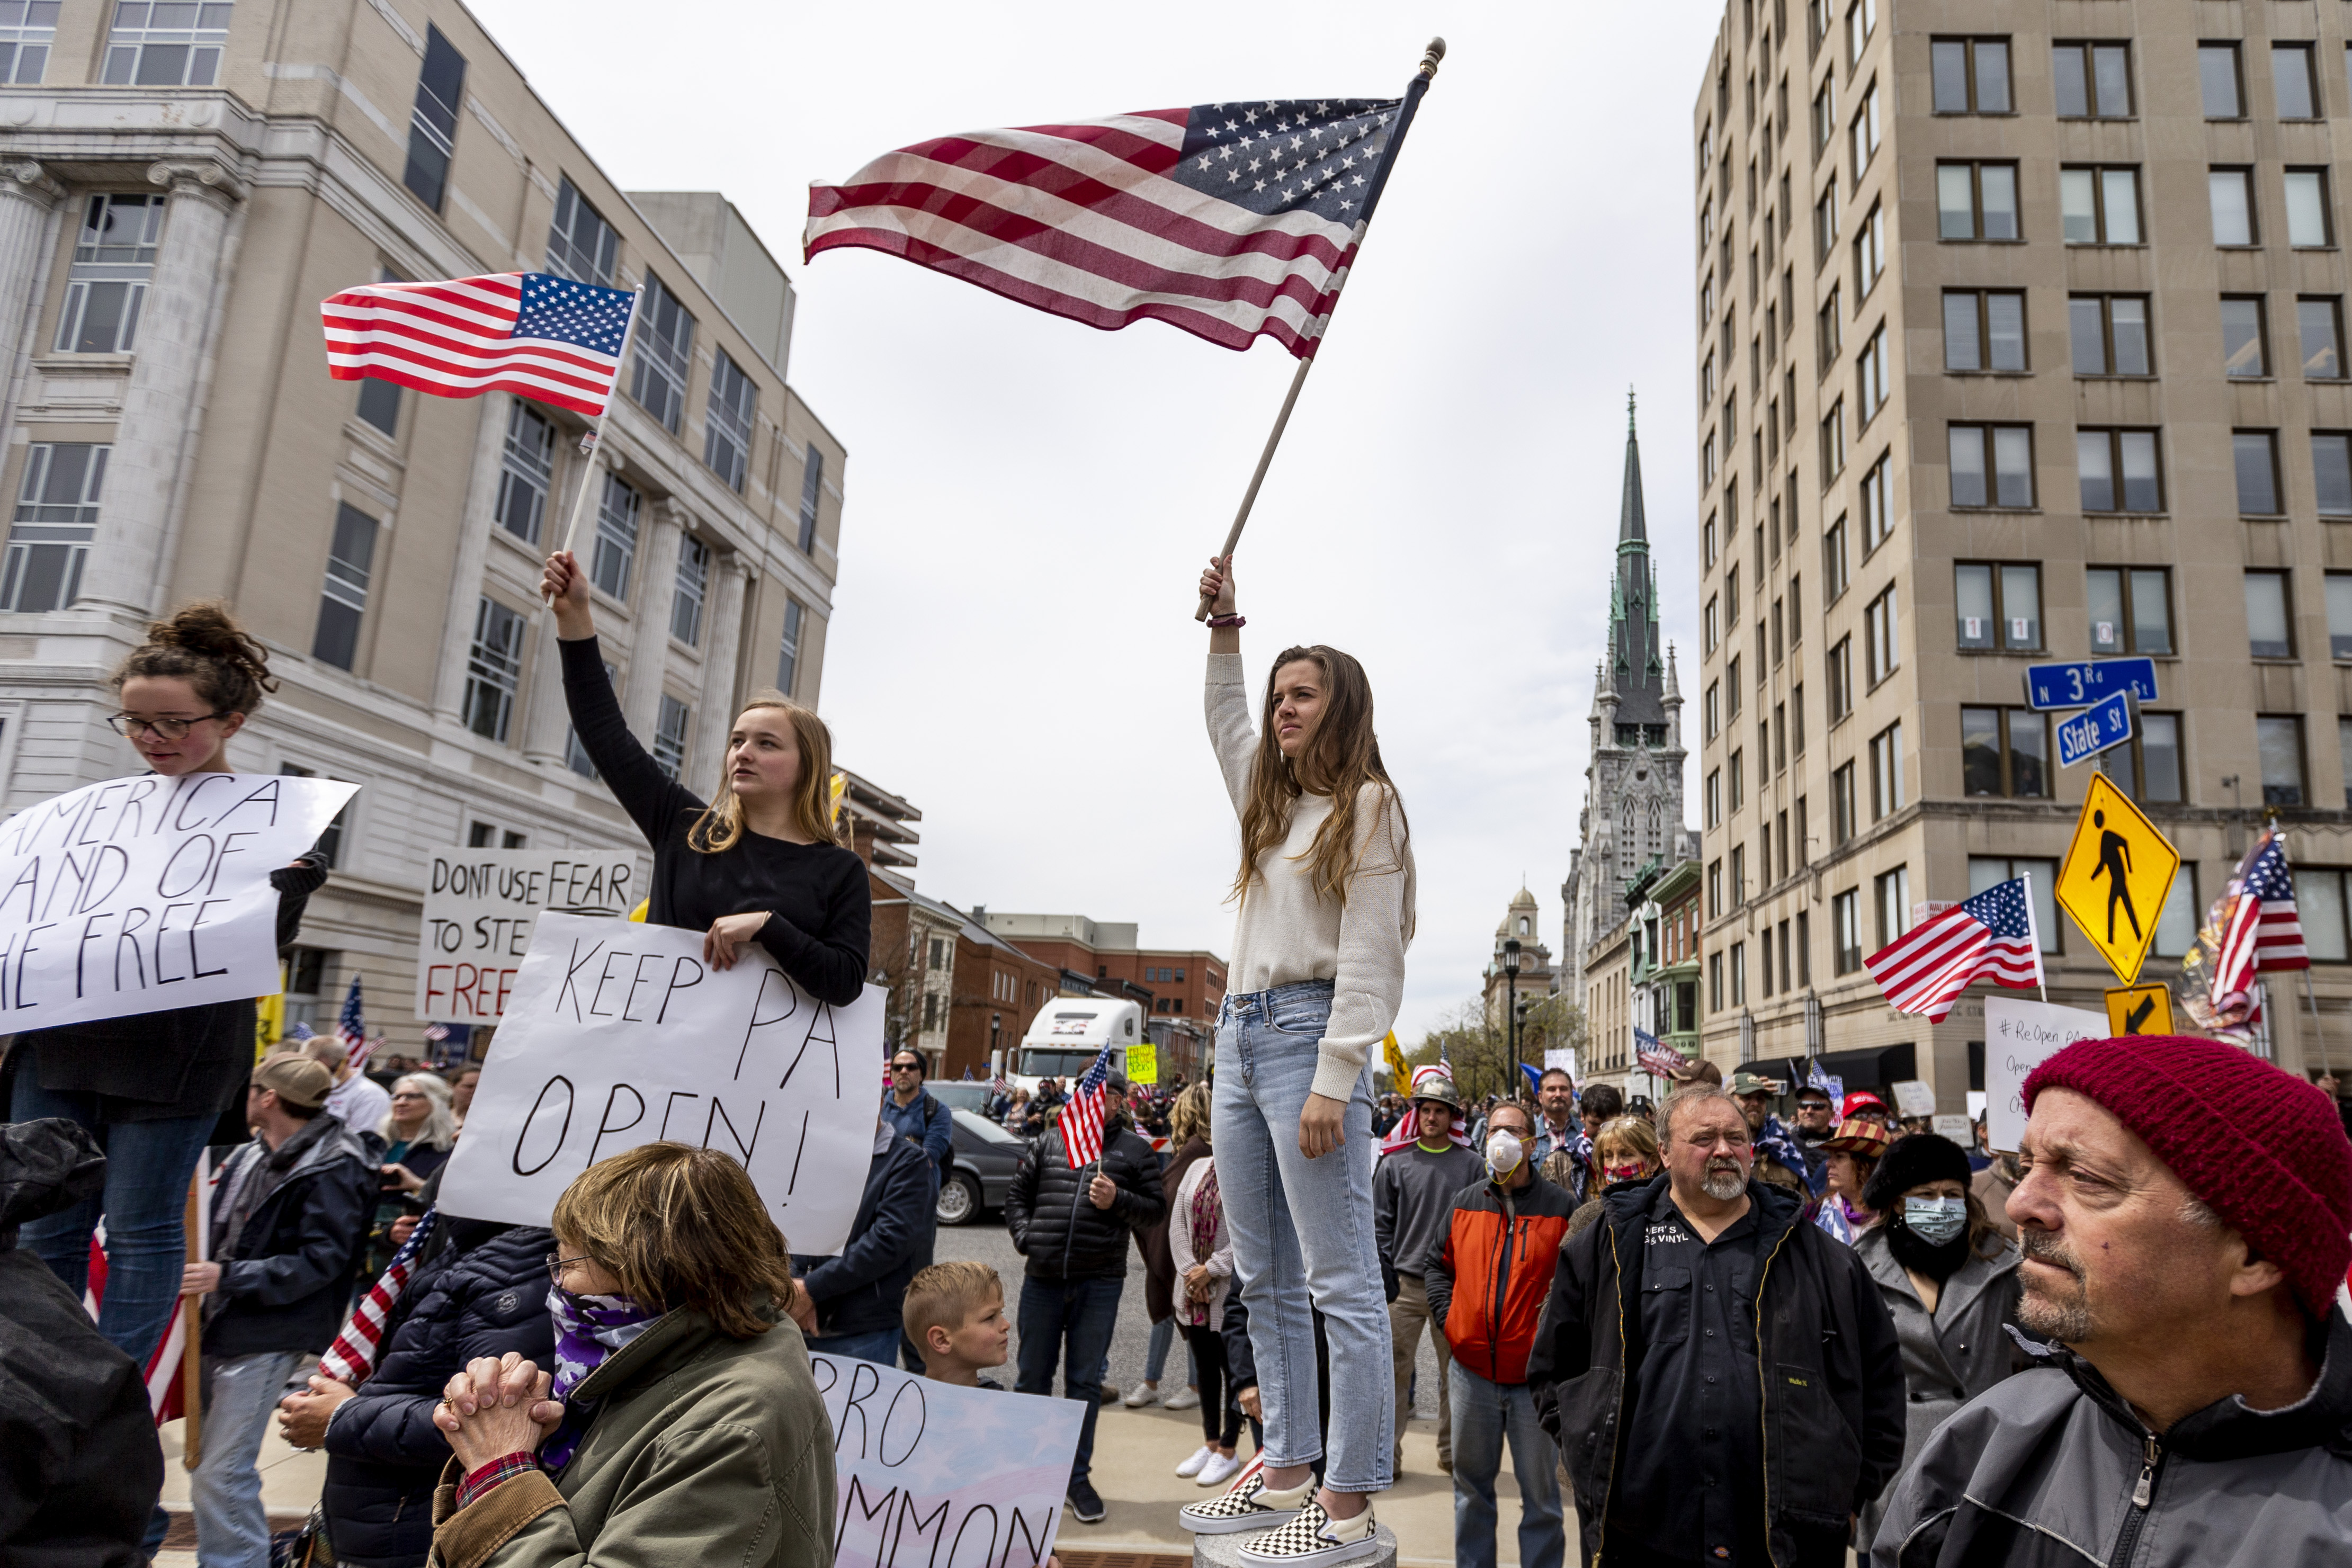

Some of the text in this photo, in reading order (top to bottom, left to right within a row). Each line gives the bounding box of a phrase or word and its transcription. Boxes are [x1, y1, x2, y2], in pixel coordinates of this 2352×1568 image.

[1969, 620, 1978, 635] 1
[2016, 621, 2024, 637] 1
[2039, 686, 2050, 703] N
[2130, 679, 2149, 697] St
[2062, 706, 2123, 759] State St
[0, 775, 280, 856] AMERICA
[0, 831, 260, 924] AND OF
[432, 858, 631, 906] DONT USE FEAR
[0, 898, 232, 1010] HE FREE
[428, 916, 530, 956] TO STE
[424, 962, 518, 1017] FREE
[556, 937, 840, 1099] KEEP PA
[1128, 1063, 1153, 1074] SUCKS!
[1636, 1037, 1682, 1065] TRUMP
[1658, 1232, 1689, 1243] VINYL
[811, 1357, 926, 1467] PRO
[835, 1473, 1053, 1568] MMON
